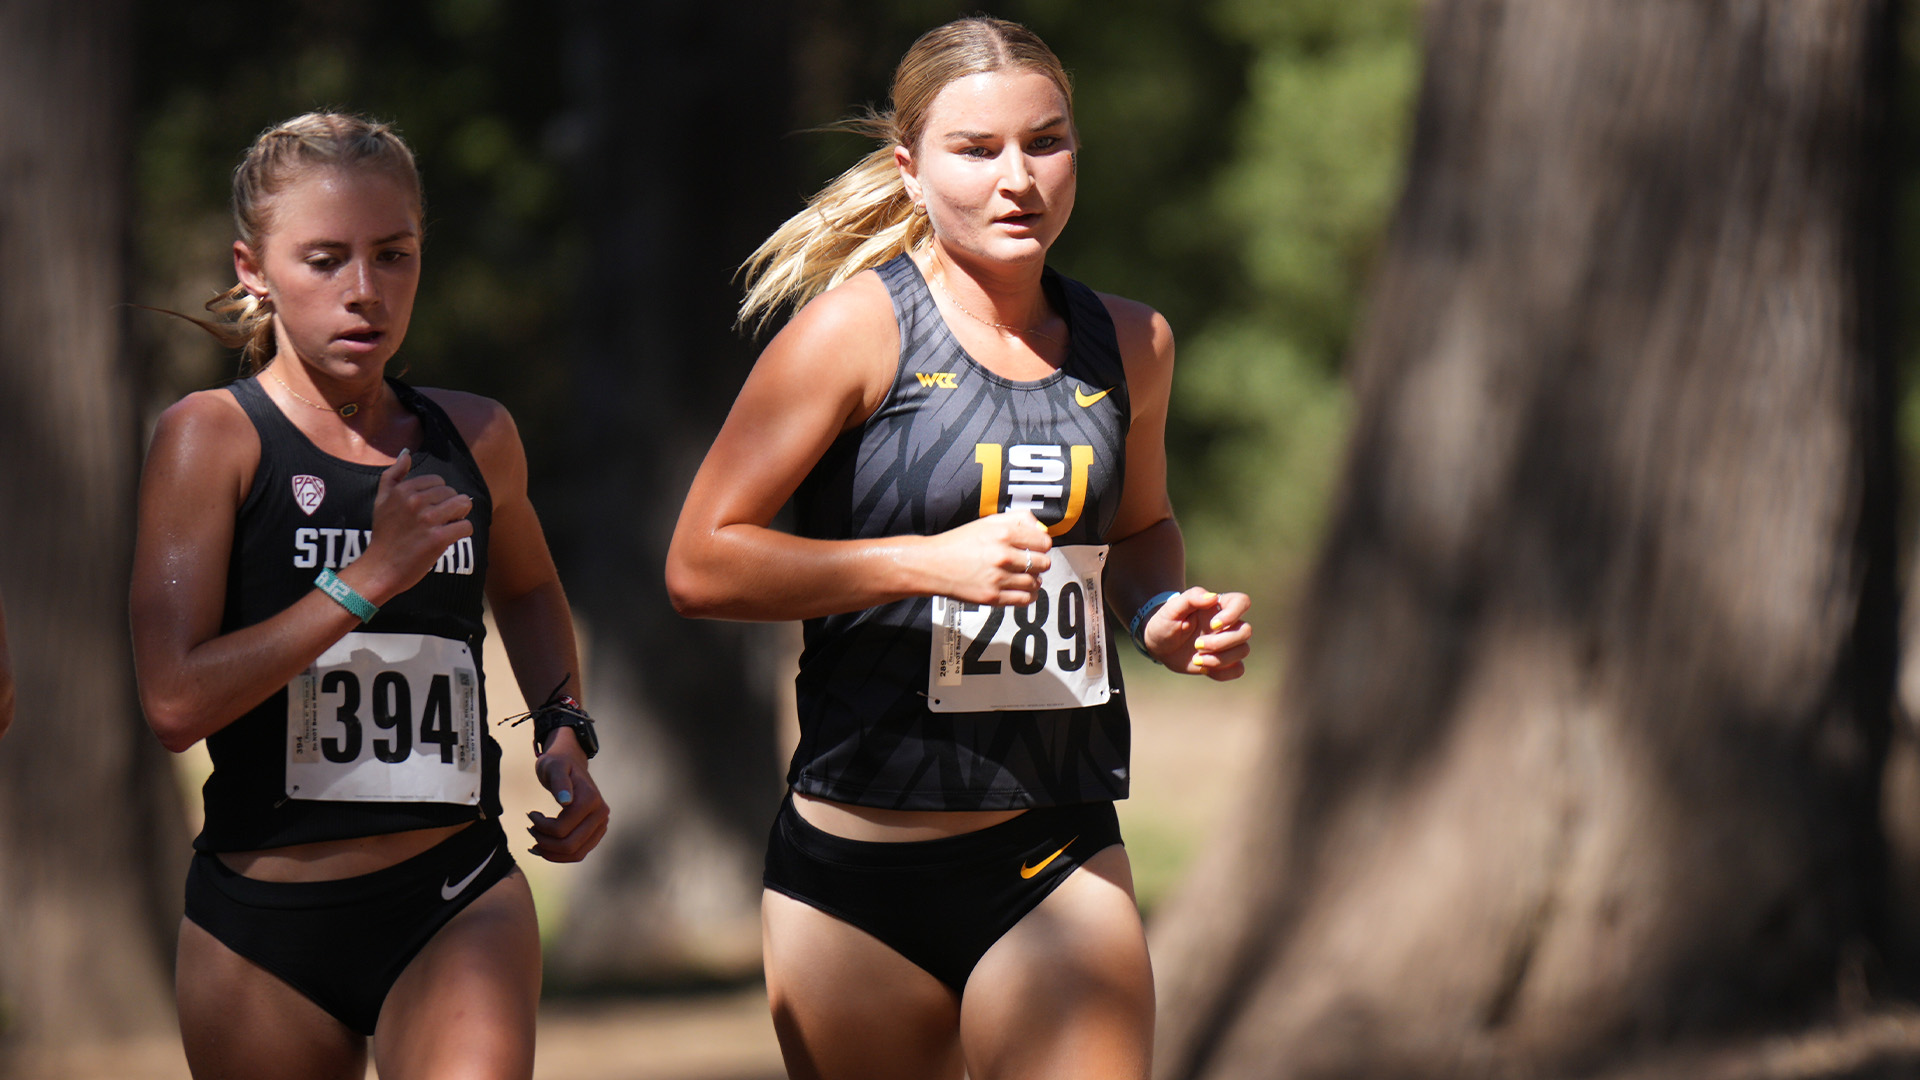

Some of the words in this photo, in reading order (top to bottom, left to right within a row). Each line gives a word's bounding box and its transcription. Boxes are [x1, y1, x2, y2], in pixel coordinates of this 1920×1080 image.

[916, 373, 958, 389] WCC
[301, 492, 317, 507] 12
[294, 527, 474, 575] STARD
[962, 581, 1087, 675] 289
[939, 659, 947, 677] 289
[321, 670, 458, 764] 394
